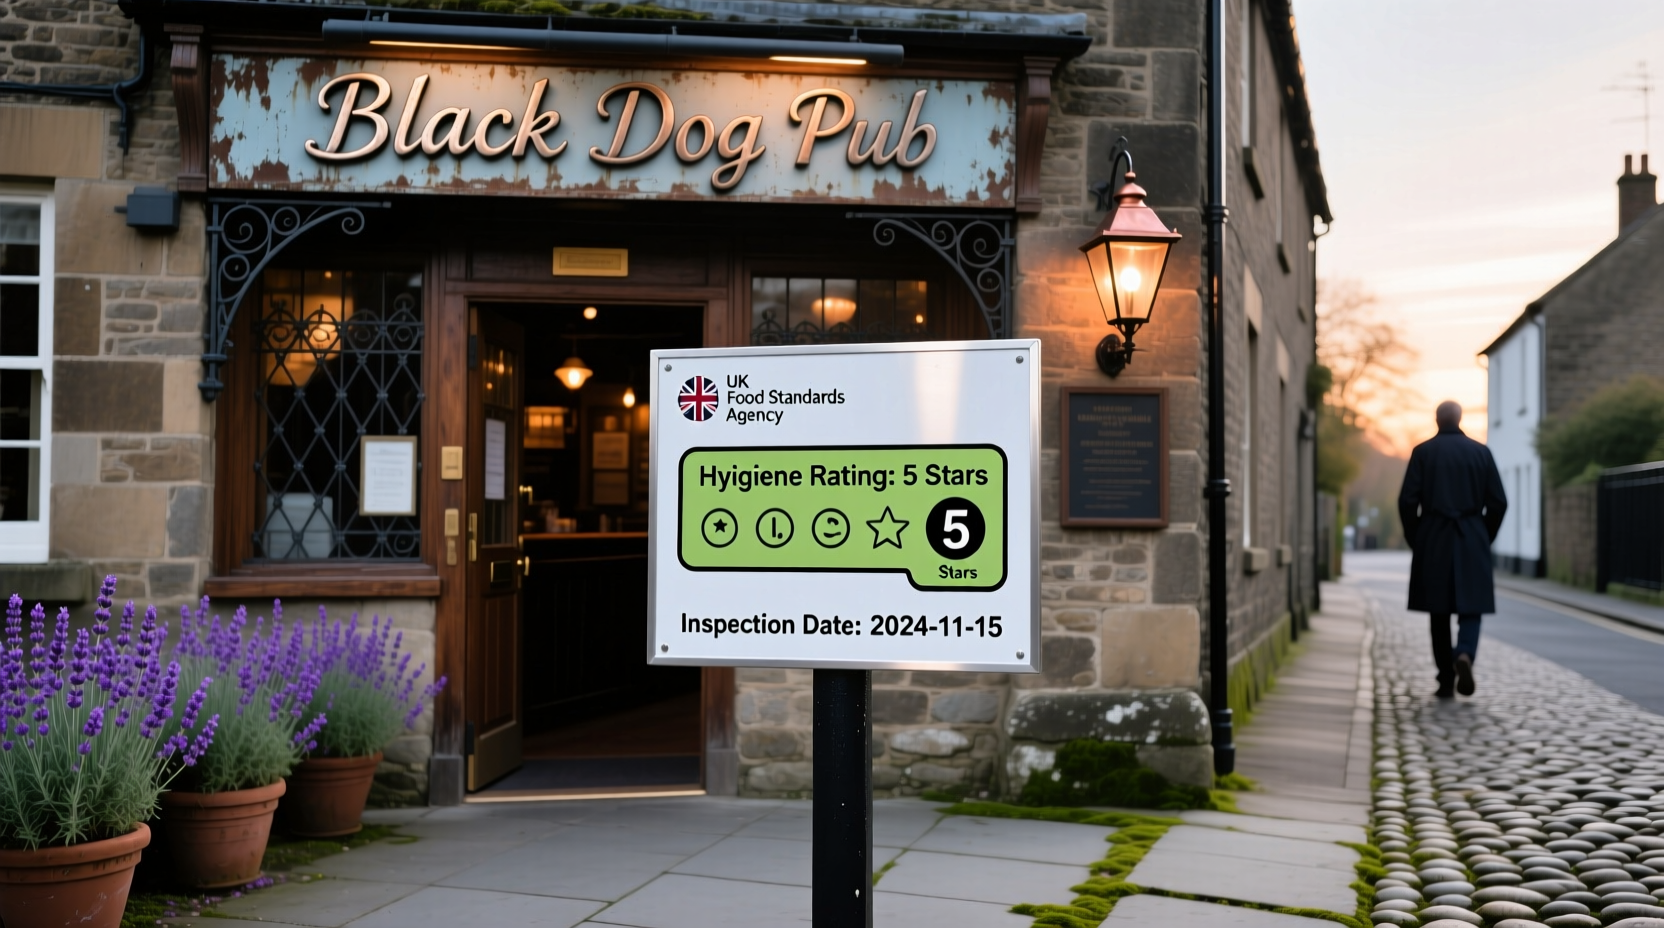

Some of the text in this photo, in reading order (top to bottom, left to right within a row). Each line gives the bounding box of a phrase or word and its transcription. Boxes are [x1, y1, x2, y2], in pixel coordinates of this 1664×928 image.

[304, 72, 938, 192] Black Dog Pub
[726, 374, 750, 389] UK
[727, 388, 846, 405] Food Standards
[725, 407, 784, 426] Agency
[699, 463, 989, 493] Hyigiene Rating: 5 Stars
[942, 509, 970, 550] 5
[938, 564, 978, 580] Stars
[681, 612, 1003, 639] Inspection Date: 2024-11-15
